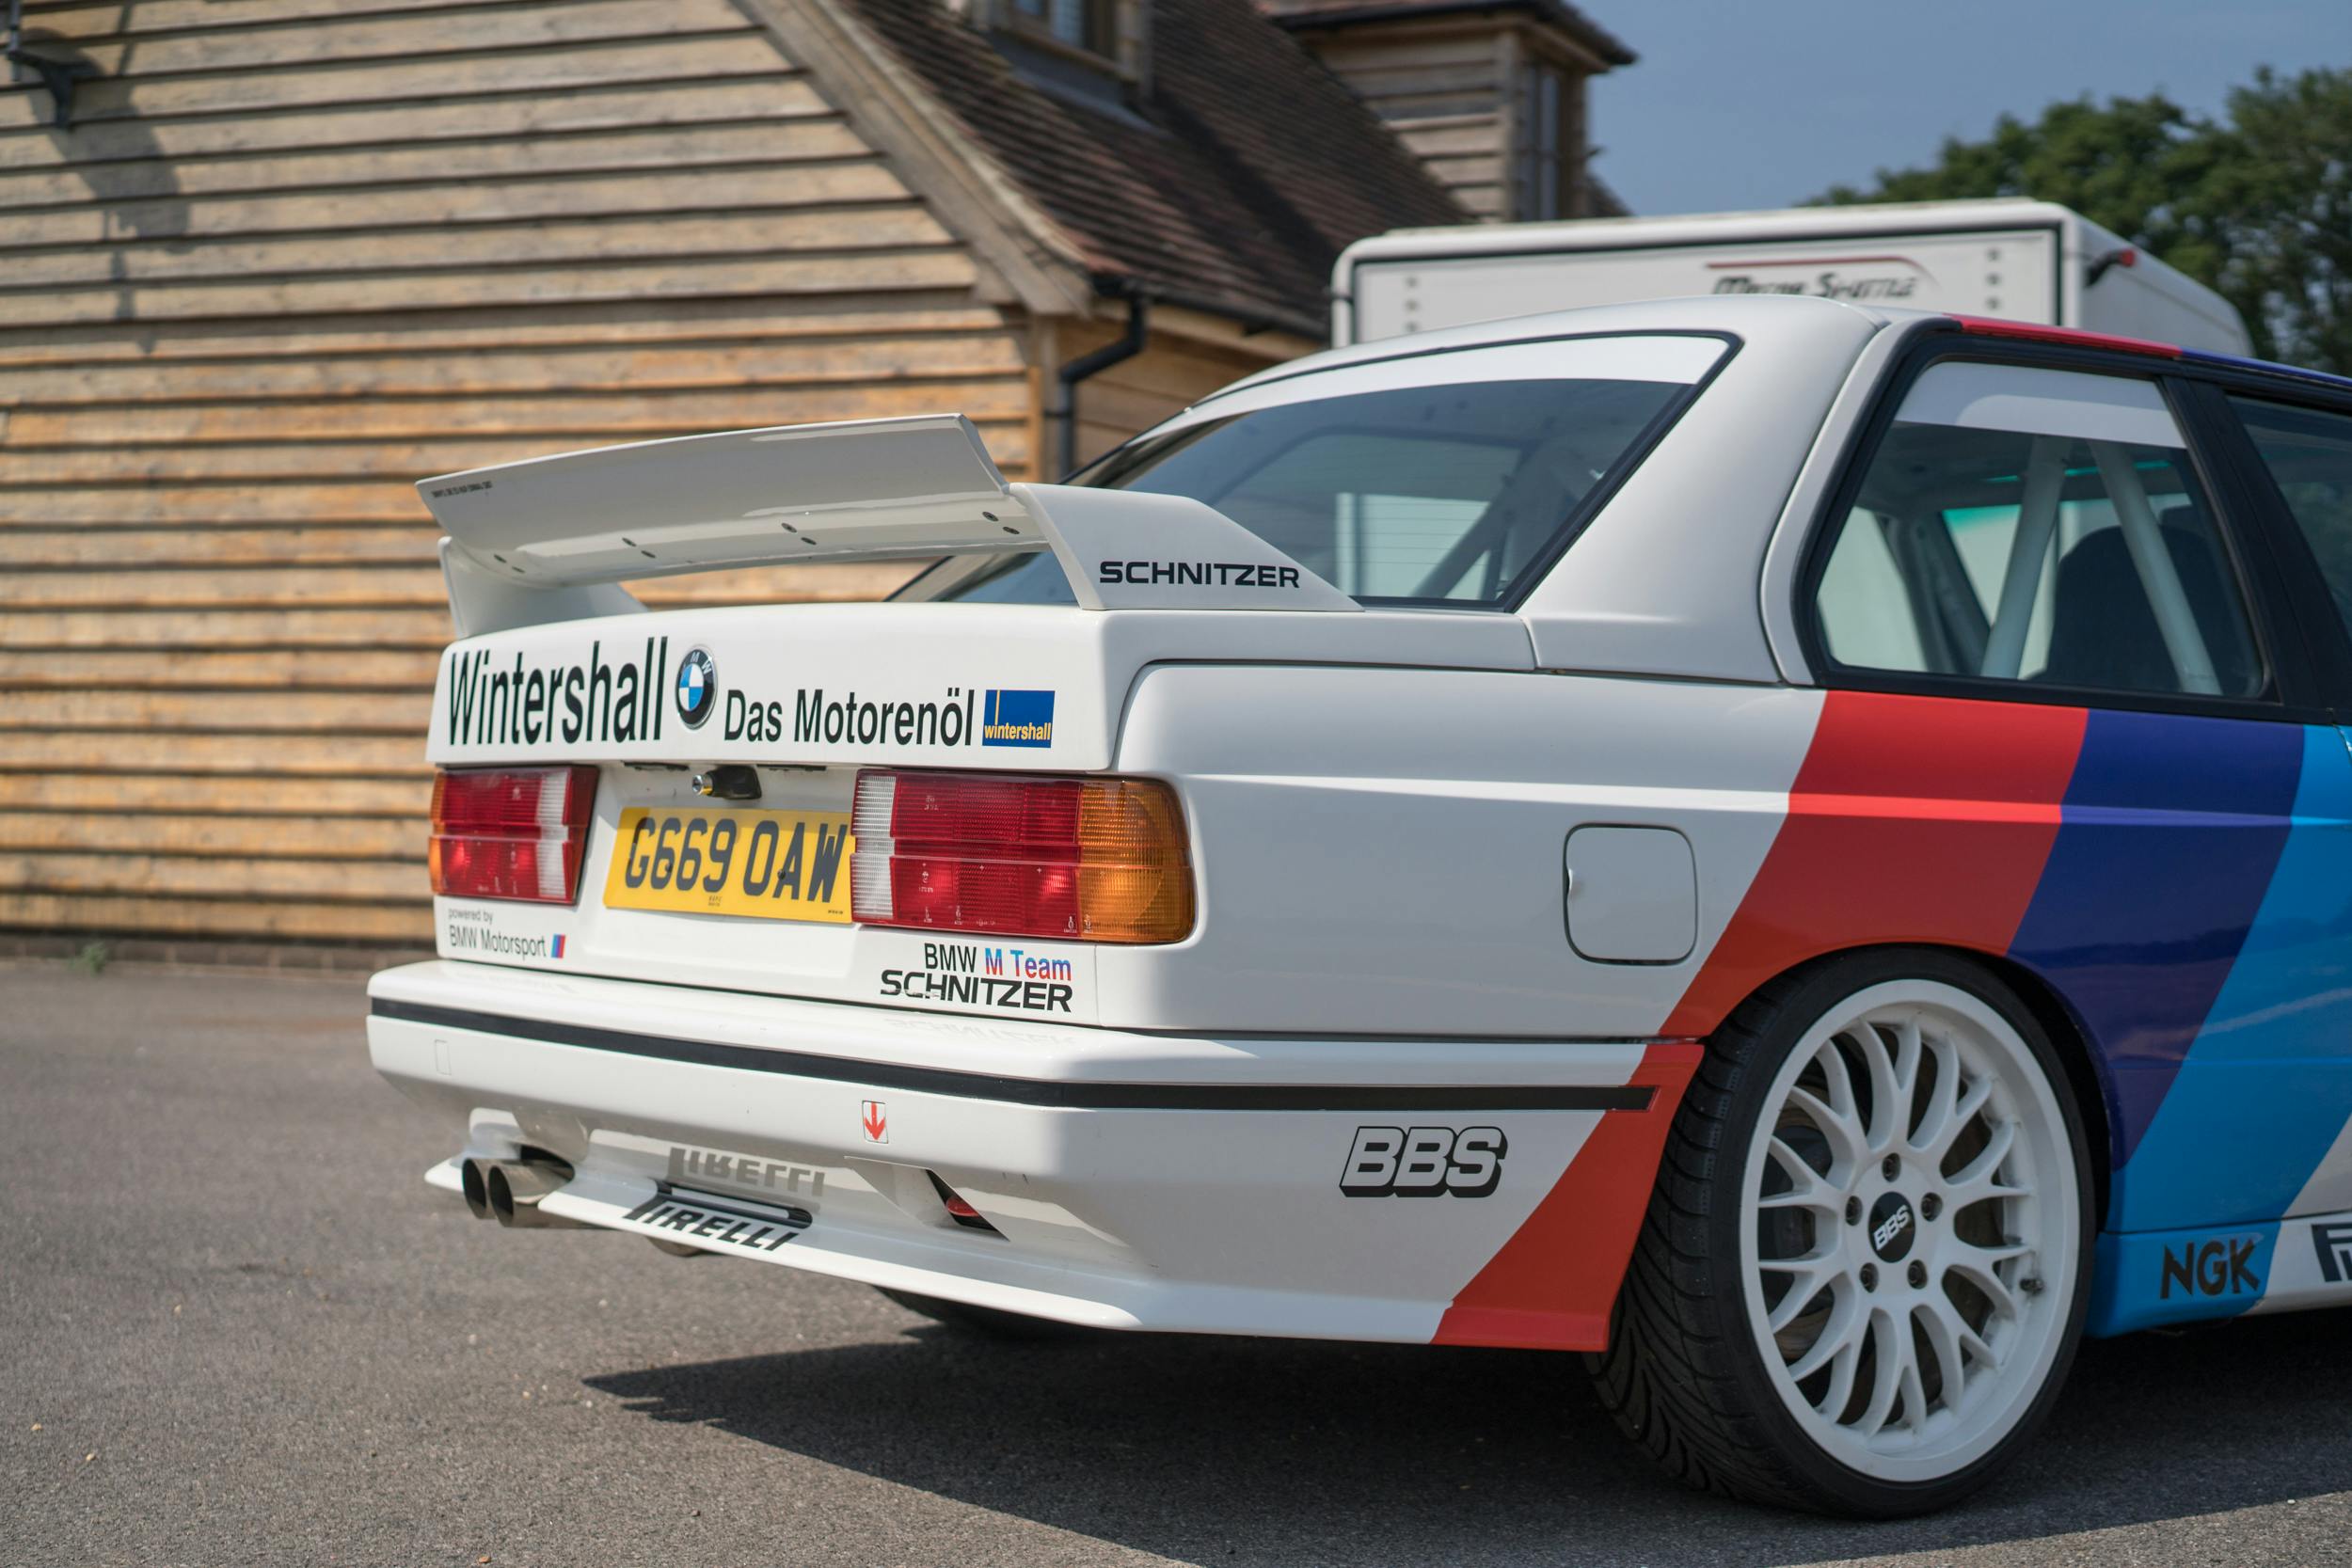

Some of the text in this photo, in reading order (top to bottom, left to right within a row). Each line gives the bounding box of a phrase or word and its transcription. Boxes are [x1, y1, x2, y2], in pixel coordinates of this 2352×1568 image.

[1100, 561, 1300, 588] SCHNITZER
[450, 636, 668, 745] Wintershall
[723, 688, 975, 746] Das Motorenöl
[984, 721, 1052, 741] wintershall
[625, 816, 849, 904] G669 OAW
[448, 908, 493, 926] powered by
[449, 925, 547, 960] BMW Motorsport
[924, 942, 1072, 981] BMW M Team
[880, 969, 1073, 1013] SCHNITZER
[1339, 1126, 1508, 1197] BBS
[622, 1178, 813, 1251] PIRELLI
[1873, 1205, 1910, 1251] BBS
[2160, 1239, 2261, 1300] NGK
